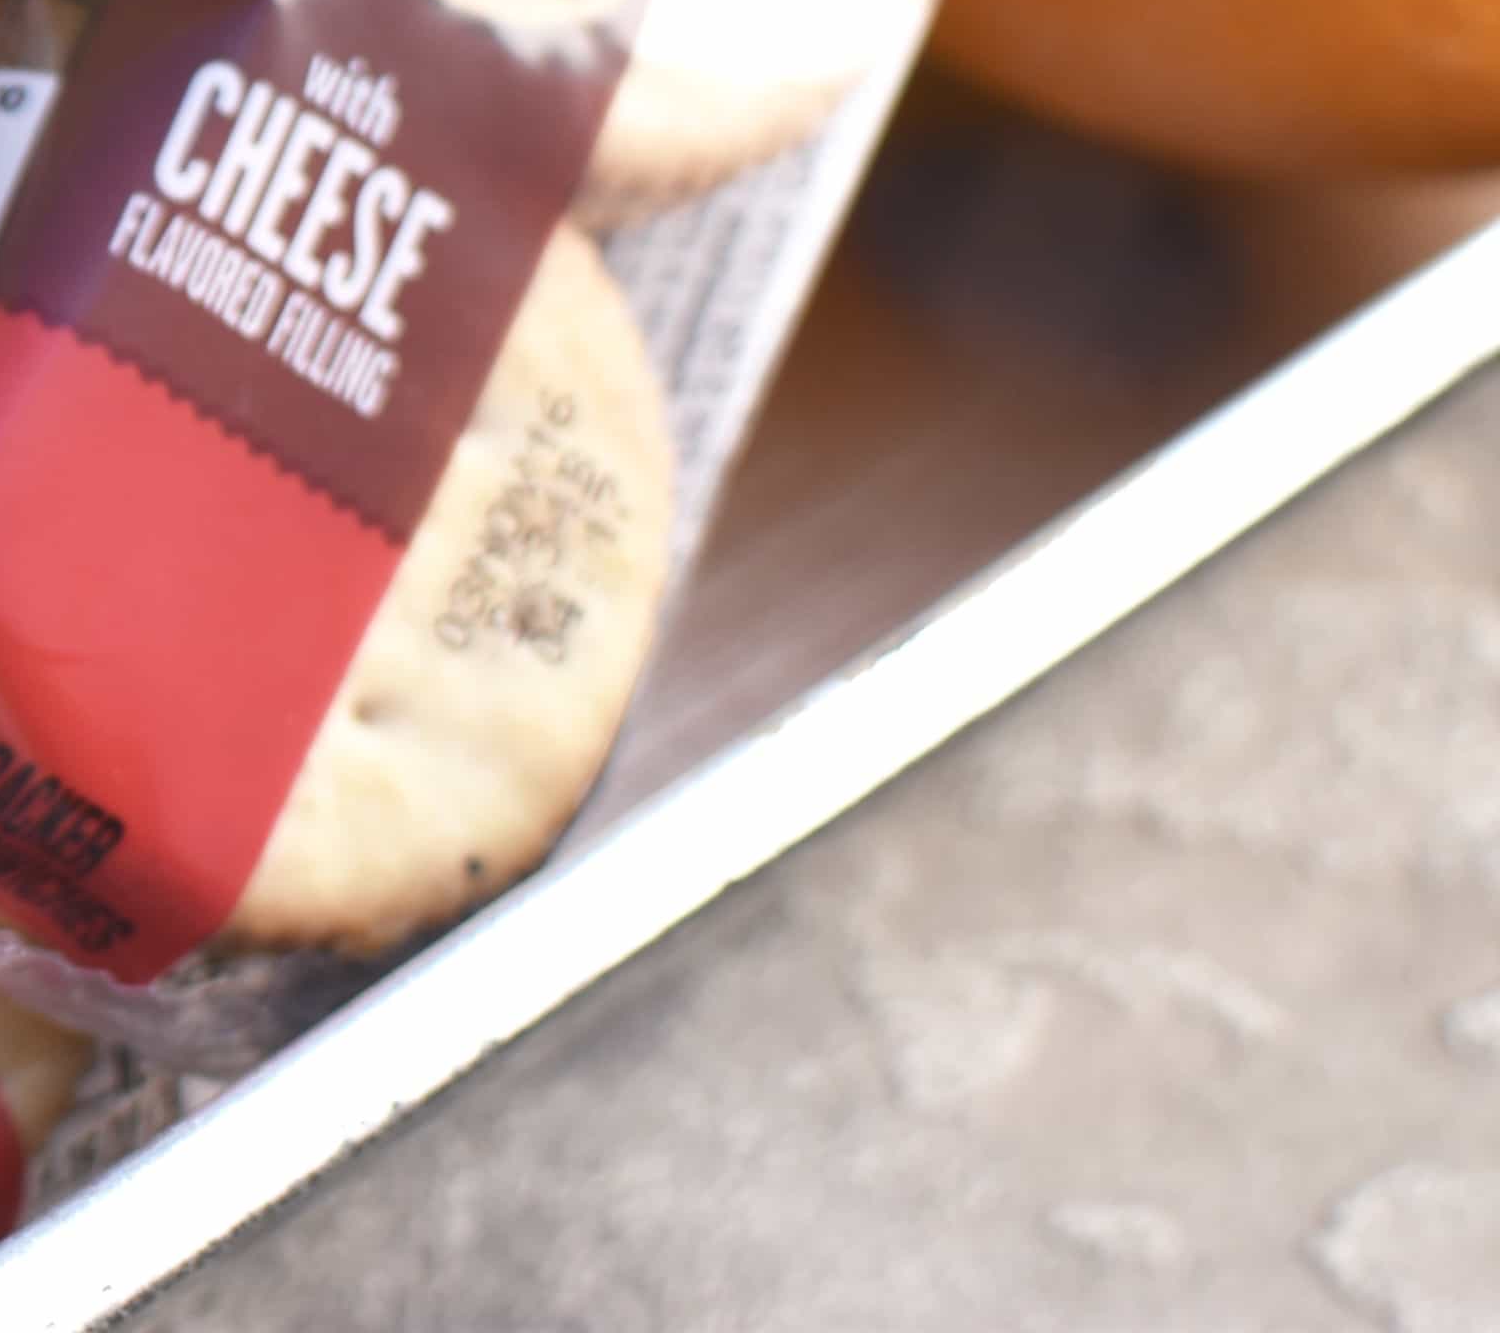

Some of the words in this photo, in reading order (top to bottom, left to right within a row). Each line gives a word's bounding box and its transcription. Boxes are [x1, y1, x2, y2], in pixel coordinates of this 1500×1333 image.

[153, 60, 454, 339] CHEESE
[304, 54, 400, 142] with
[109, 192, 275, 342] FLAVORED
[266, 296, 402, 423] FILLING
